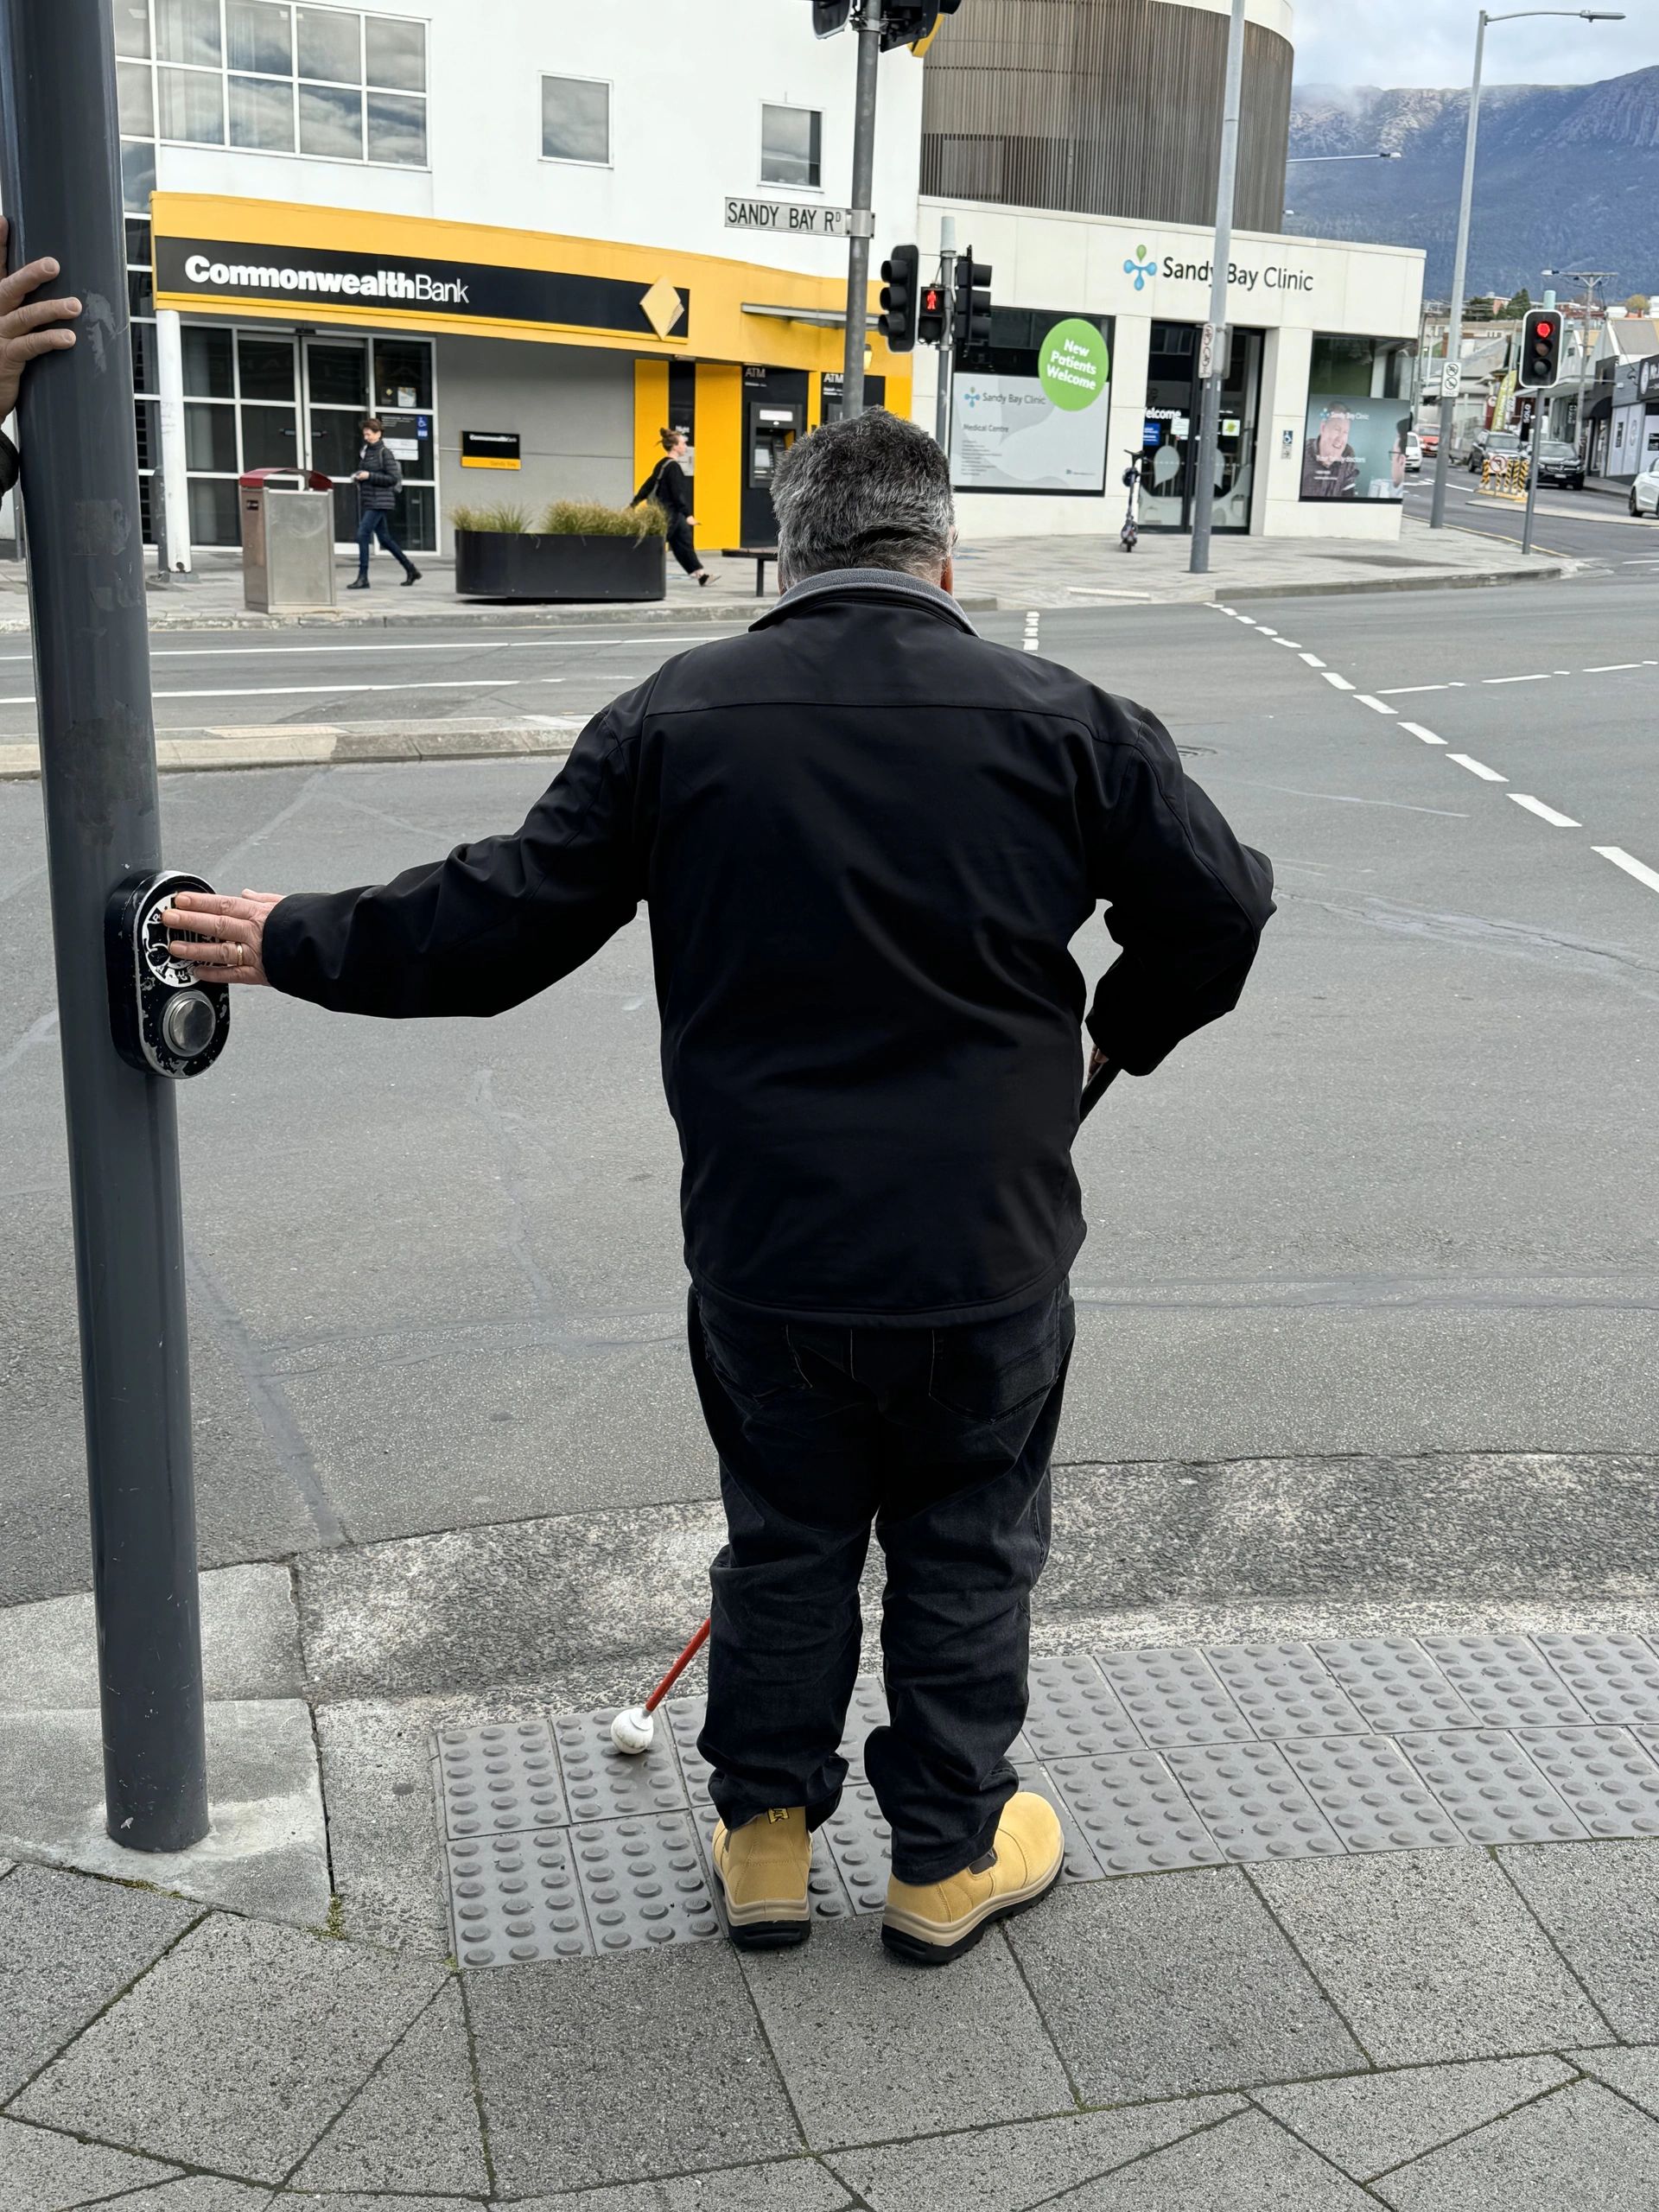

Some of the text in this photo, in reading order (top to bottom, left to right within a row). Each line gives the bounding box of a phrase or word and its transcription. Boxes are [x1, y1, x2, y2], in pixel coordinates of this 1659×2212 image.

[728, 201, 779, 226] SANDY
[789, 207, 817, 231] BAY
[184, 255, 470, 303] CommonwealthBank
[1227, 263, 1258, 292] Bay
[1263, 266, 1314, 292] Clinic
[1064, 338, 1090, 358] New
[744, 367, 766, 378] ATM
[1050, 350, 1097, 375] Patients
[823, 373, 844, 384] ATM
[1046, 364, 1097, 391] Welcome
[982, 392, 1047, 406] Sandy Bay Clinic
[1145, 407, 1181, 419] elcome
[963, 423, 987, 432] Medical
